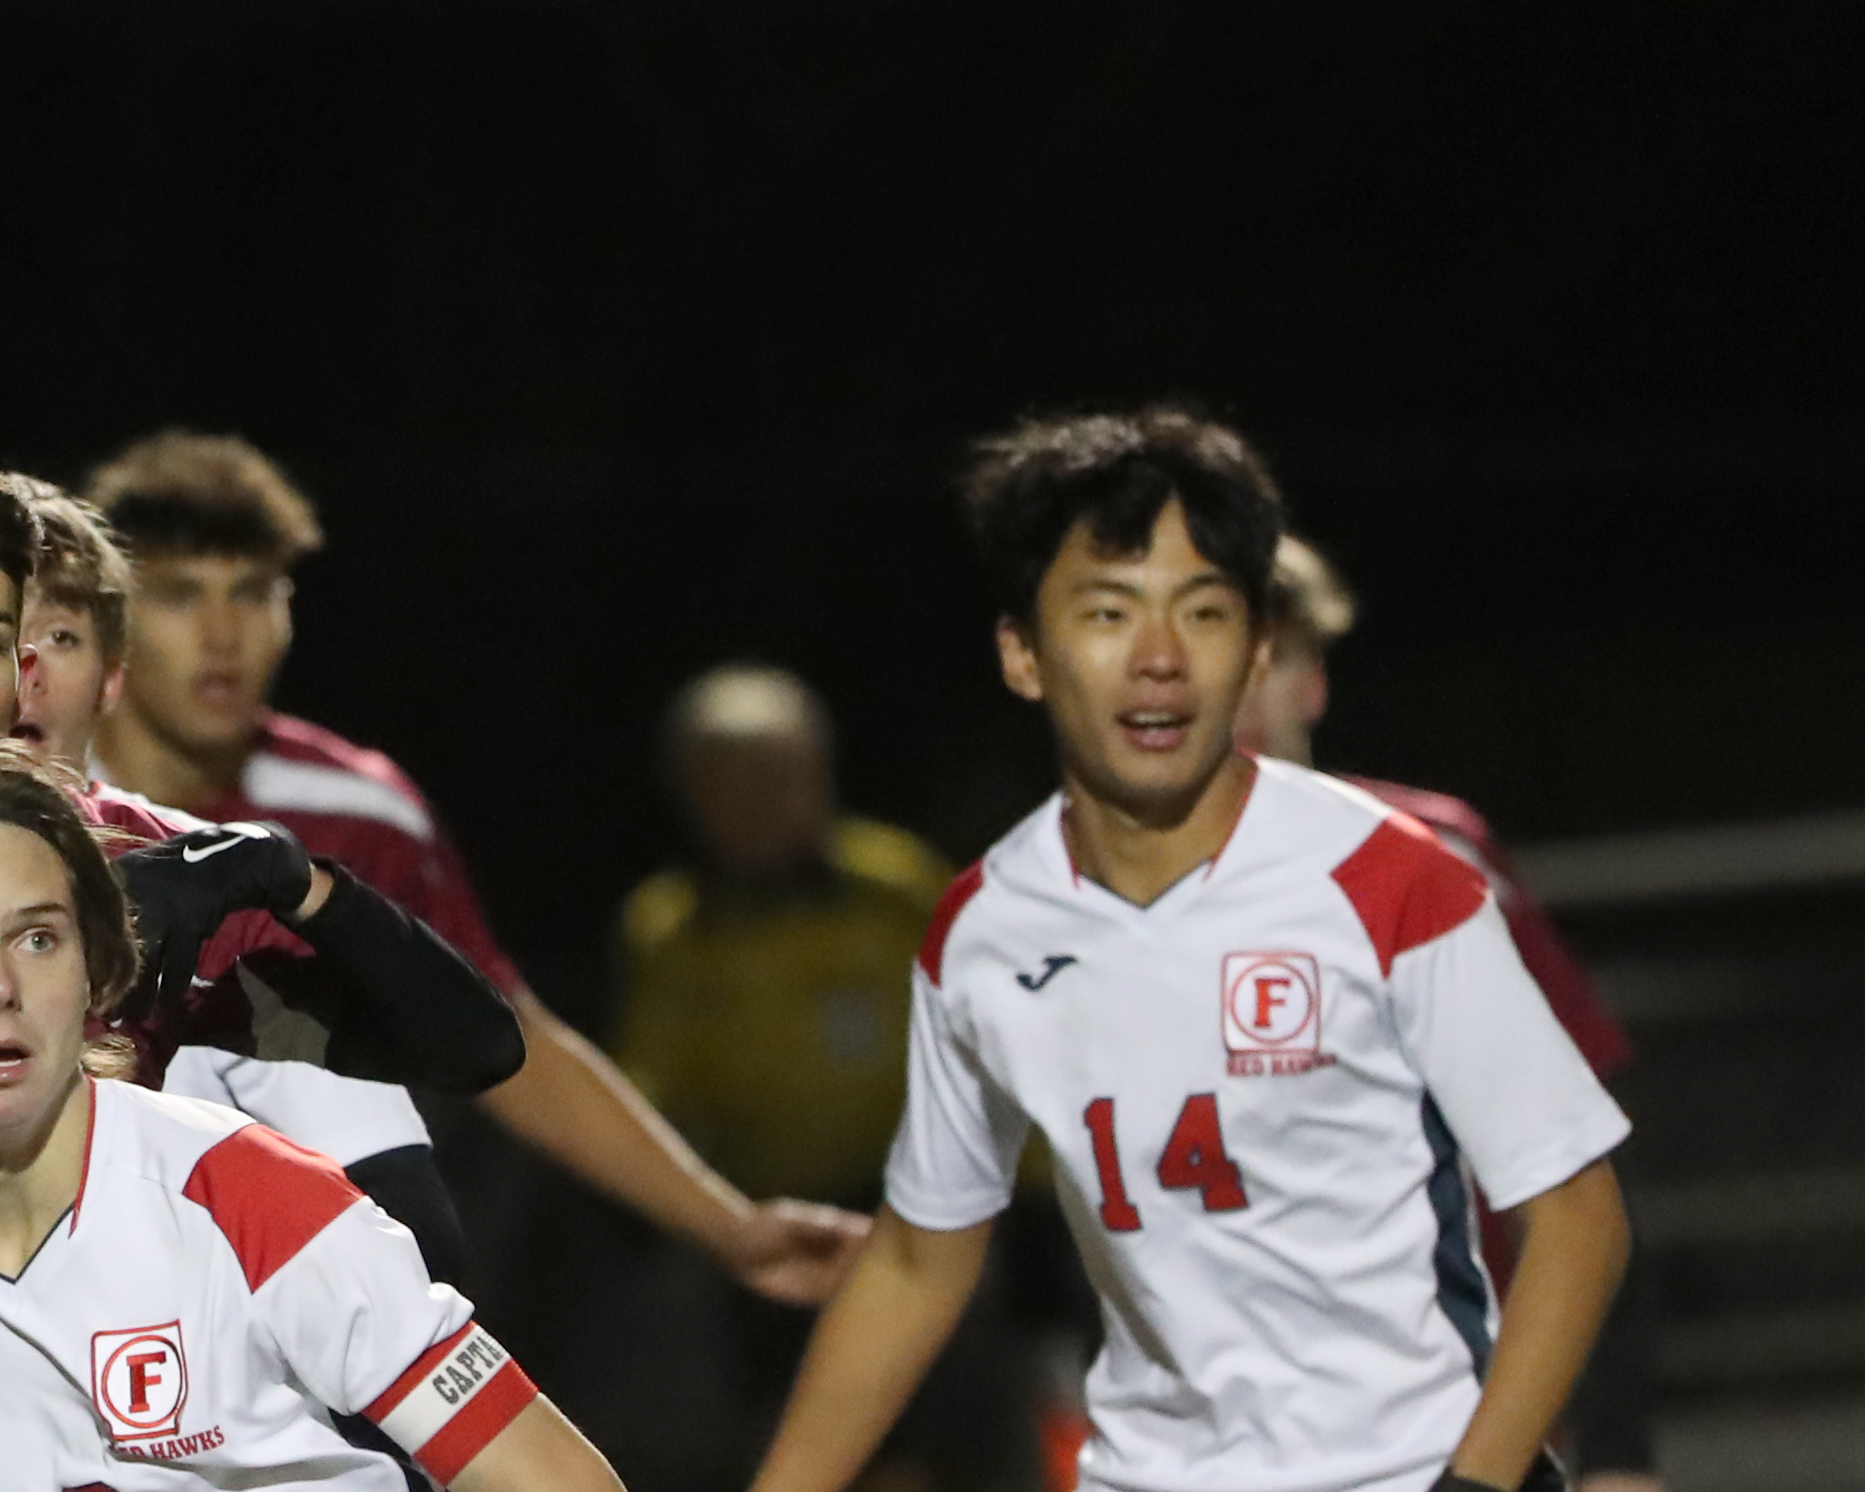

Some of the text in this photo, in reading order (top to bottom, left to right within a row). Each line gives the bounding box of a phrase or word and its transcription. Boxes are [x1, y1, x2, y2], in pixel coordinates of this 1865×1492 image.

[1254, 978, 1292, 1028] F
[1083, 1092, 1249, 1232] 14
[126, 1351, 166, 1413] F
[149, 1425, 225, 1460] HAWKS
